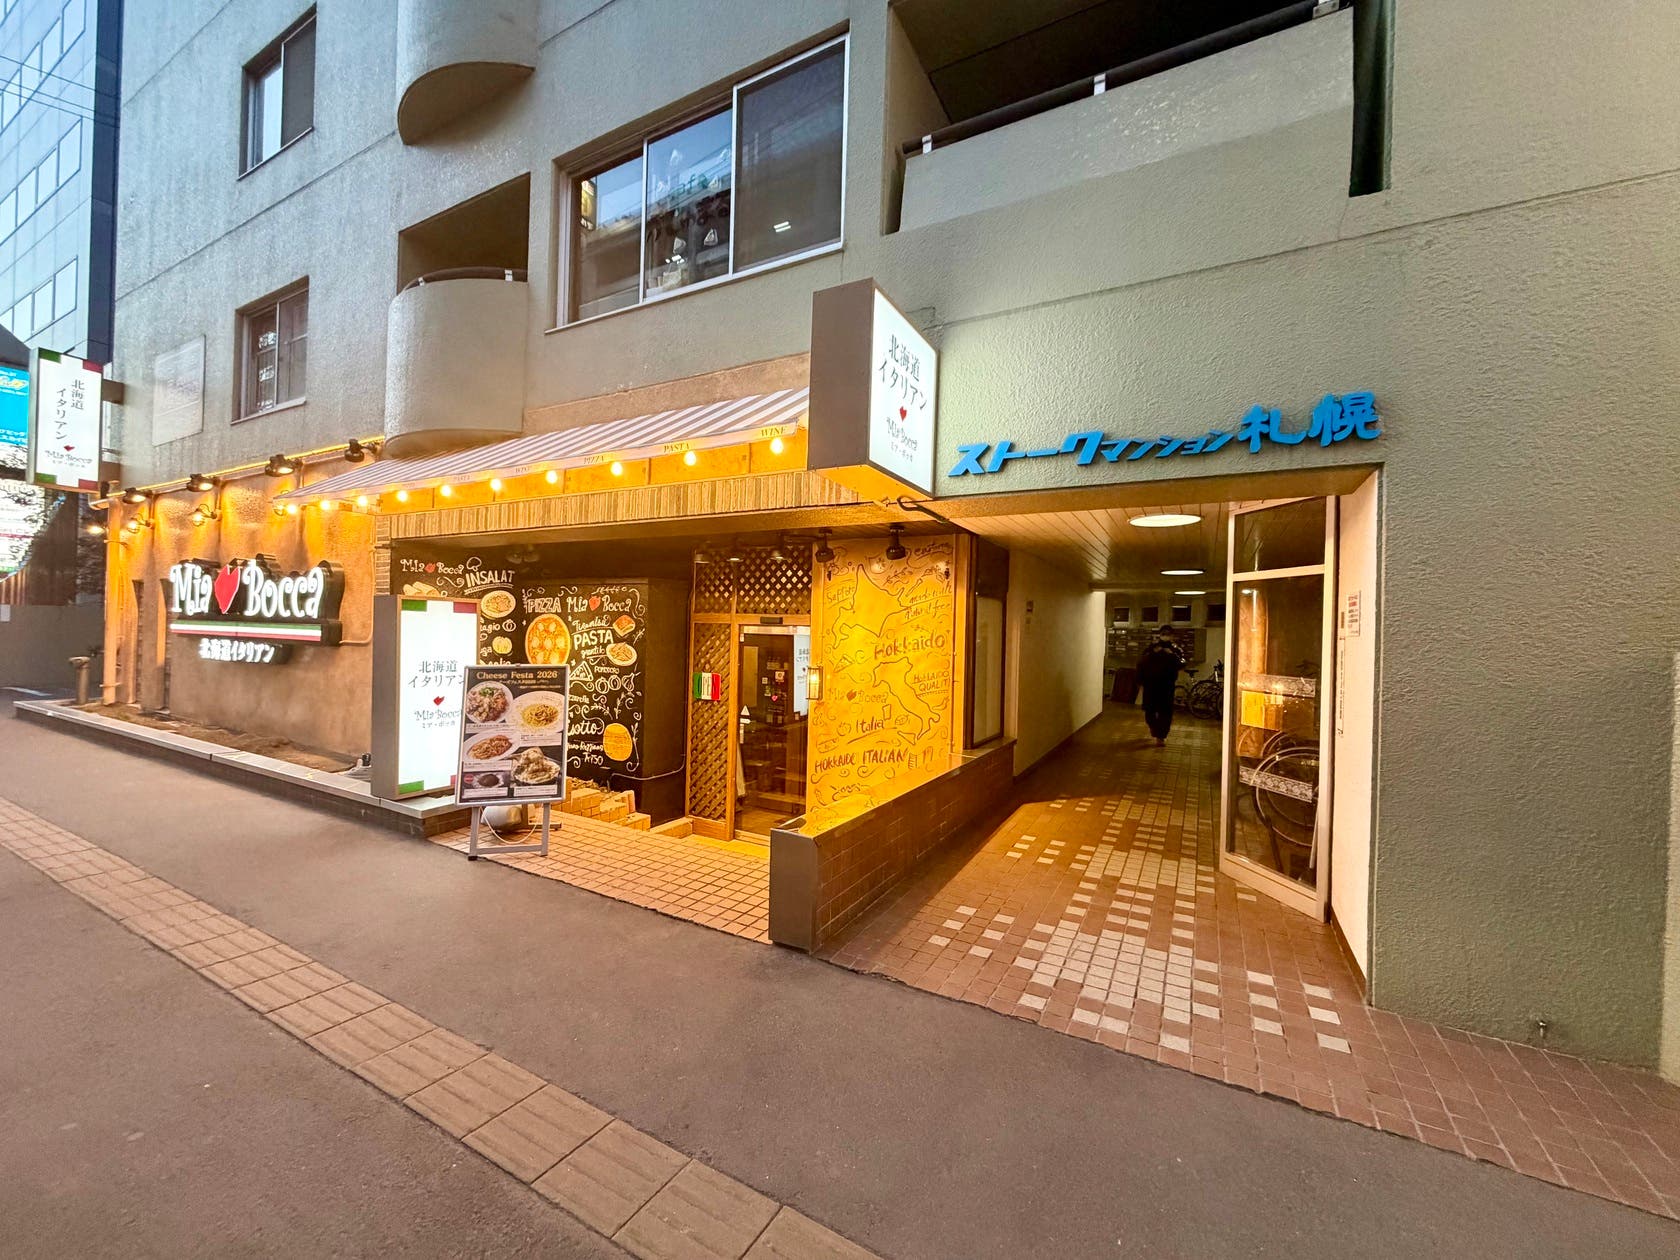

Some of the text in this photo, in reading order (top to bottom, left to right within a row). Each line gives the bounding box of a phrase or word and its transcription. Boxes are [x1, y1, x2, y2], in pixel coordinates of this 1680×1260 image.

[889, 334, 919, 382] 北海道
[879, 359, 928, 410] イタリアン
[71, 379, 85, 410] 北海道
[54, 388, 67, 440] イタリアン
[760, 426, 787, 437] WINE
[663, 442, 690, 453] PASTA
[436, 561, 465, 575] Bocca
[170, 558, 324, 619] Mia Bocca
[527, 597, 562, 613] PIZZA
[567, 595, 632, 613] Mia Bocca
[573, 629, 614, 650] PASTA
[874, 629, 945, 660] Hokkaido
[198, 637, 275, 663] 北海道イタリアン
[419, 660, 458, 673] 北海道
[476, 670, 558, 679] Cheese Festa 2026
[856, 716, 884, 734] Italia
[862, 747, 908, 764] ITALIAN
